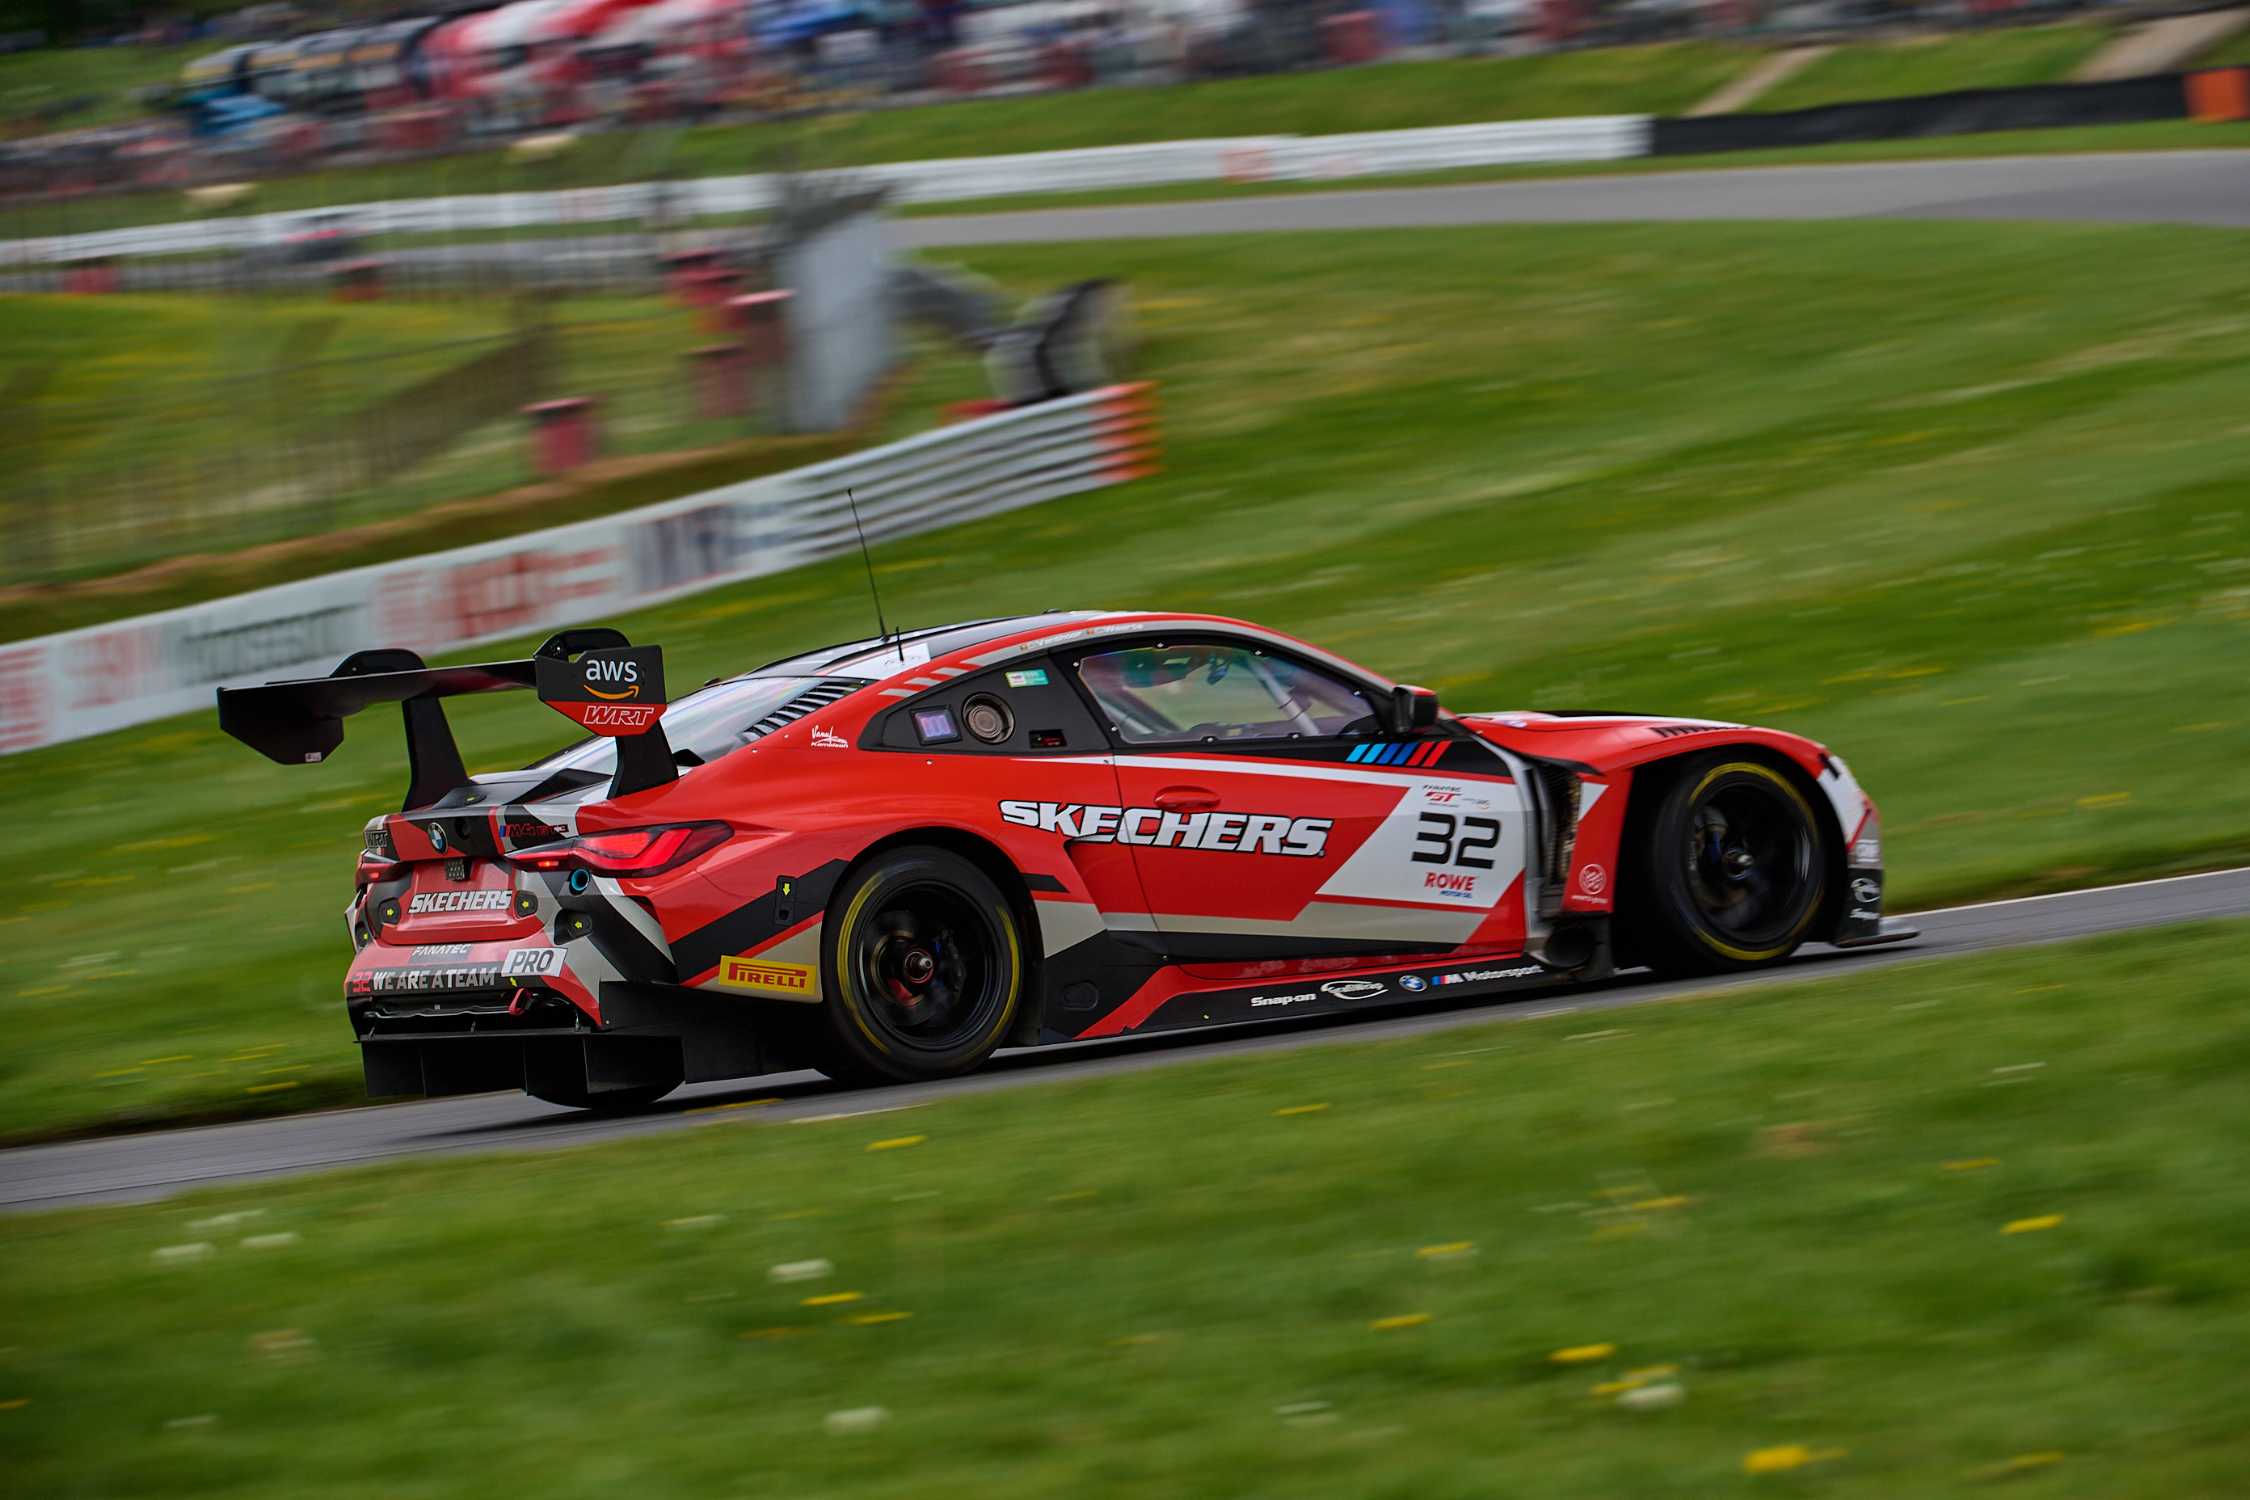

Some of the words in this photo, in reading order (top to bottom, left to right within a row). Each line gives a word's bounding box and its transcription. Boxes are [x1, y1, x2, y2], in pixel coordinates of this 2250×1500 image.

[585, 659, 638, 683] aws
[583, 705, 655, 726] WRT
[999, 800, 1335, 857] SKECHERS
[1411, 811, 1501, 869] 32
[1424, 872, 1476, 891] ROWE
[407, 889, 513, 914] SKECHERS
[412, 943, 472, 956] FANATEC
[509, 949, 554, 974] PRO
[373, 971, 395, 990] WE
[396, 970, 431, 990] ARE
[445, 967, 497, 988] TEAM
[728, 962, 807, 988] PIRELLI
[1251, 993, 1316, 1007] Snap-on
